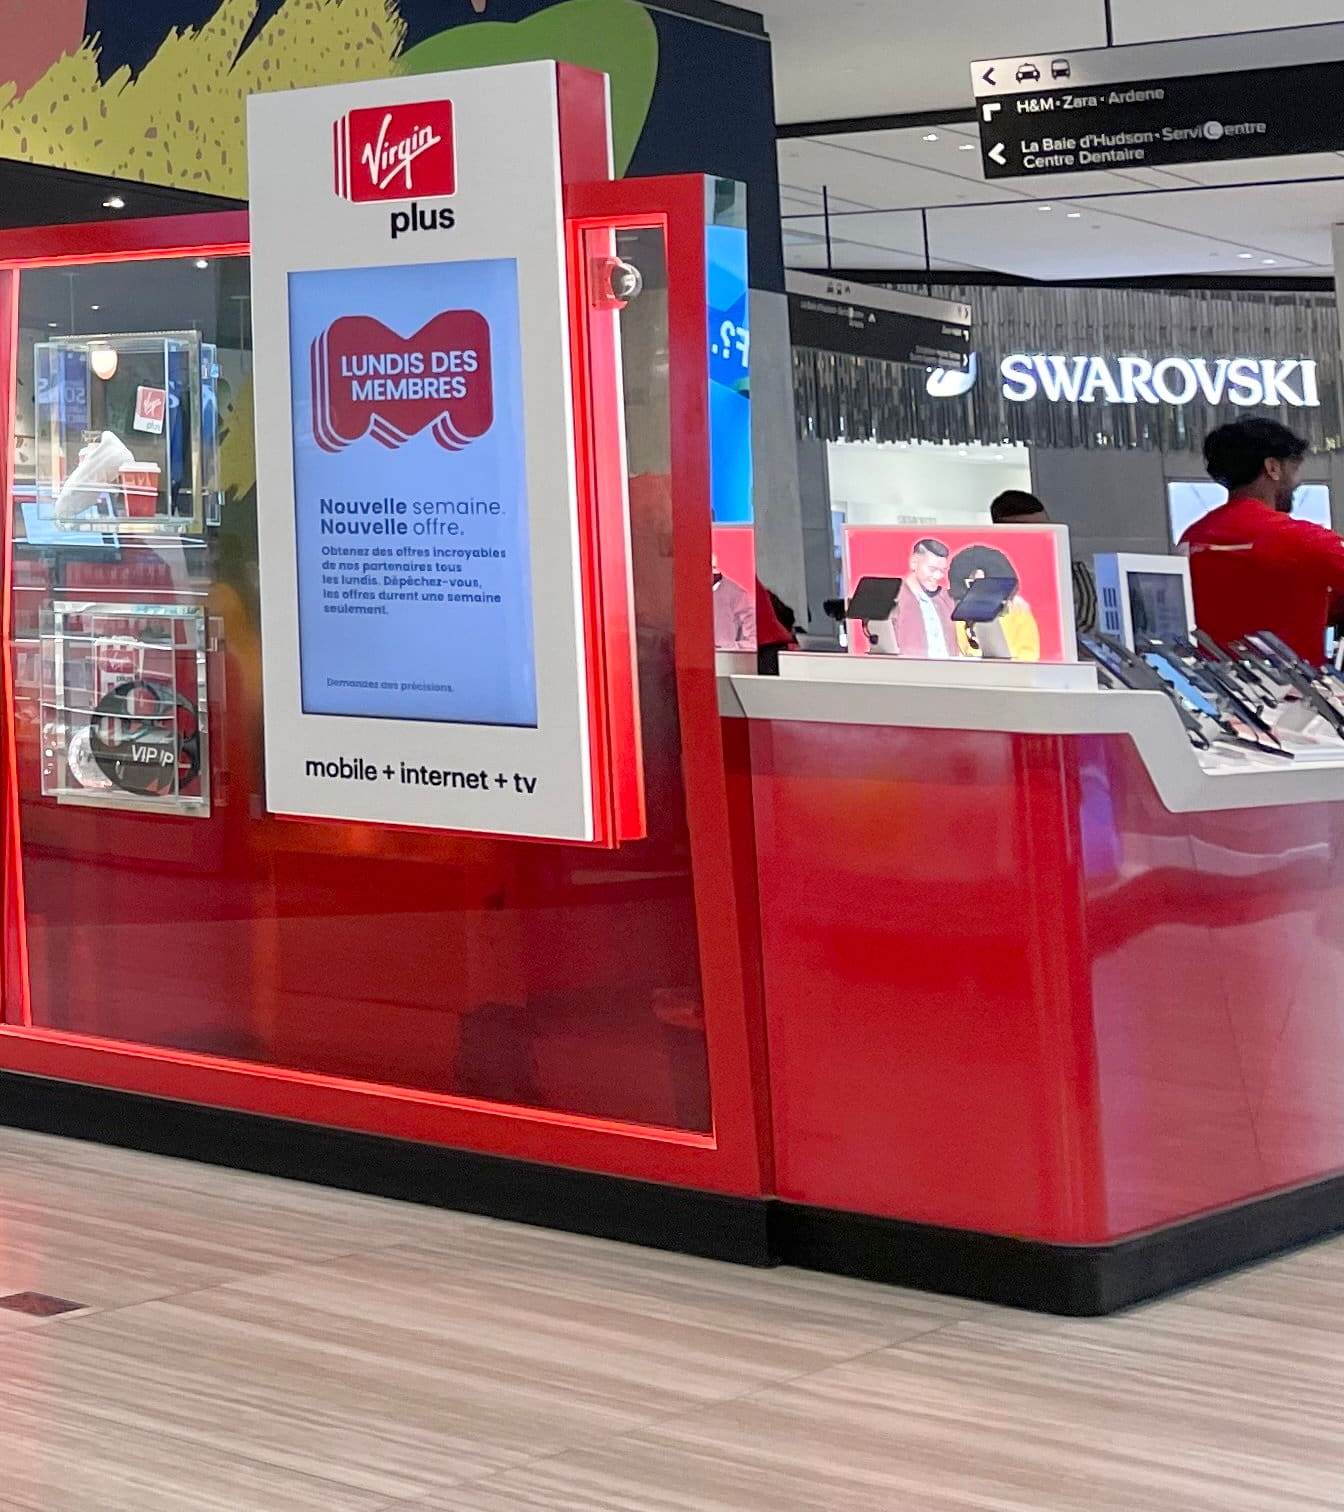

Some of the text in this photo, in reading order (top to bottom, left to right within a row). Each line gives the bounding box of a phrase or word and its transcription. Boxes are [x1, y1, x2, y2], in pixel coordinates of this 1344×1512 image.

[1016, 88, 1165, 114] H&M Zara Ardene
[361, 113, 441, 189] Virgin
[1021, 140, 1039, 153] La
[1043, 137, 1076, 151] Baie
[1080, 133, 1153, 148] d'Hudson
[1023, 148, 1145, 169] Centre Dentaire
[390, 202, 455, 238] plus
[341, 349, 478, 377] LUNDIS DES
[352, 377, 467, 401] MEMBRES
[1000, 353, 1321, 407] SWAROVSKI
[320, 498, 506, 515] Nouvelle semaine.
[321, 518, 464, 535] Nouvelle offre.
[321, 546, 506, 560] Obtenez des offres incroyables
[322, 560, 462, 573] de nos partenaires tous
[322, 575, 338, 584] les
[342, 575, 381, 585] lundis.
[323, 589, 501, 602] les offres durent une semaine
[131, 744, 158, 764] VIP
[305, 756, 537, 793] mobile + internet + tv
